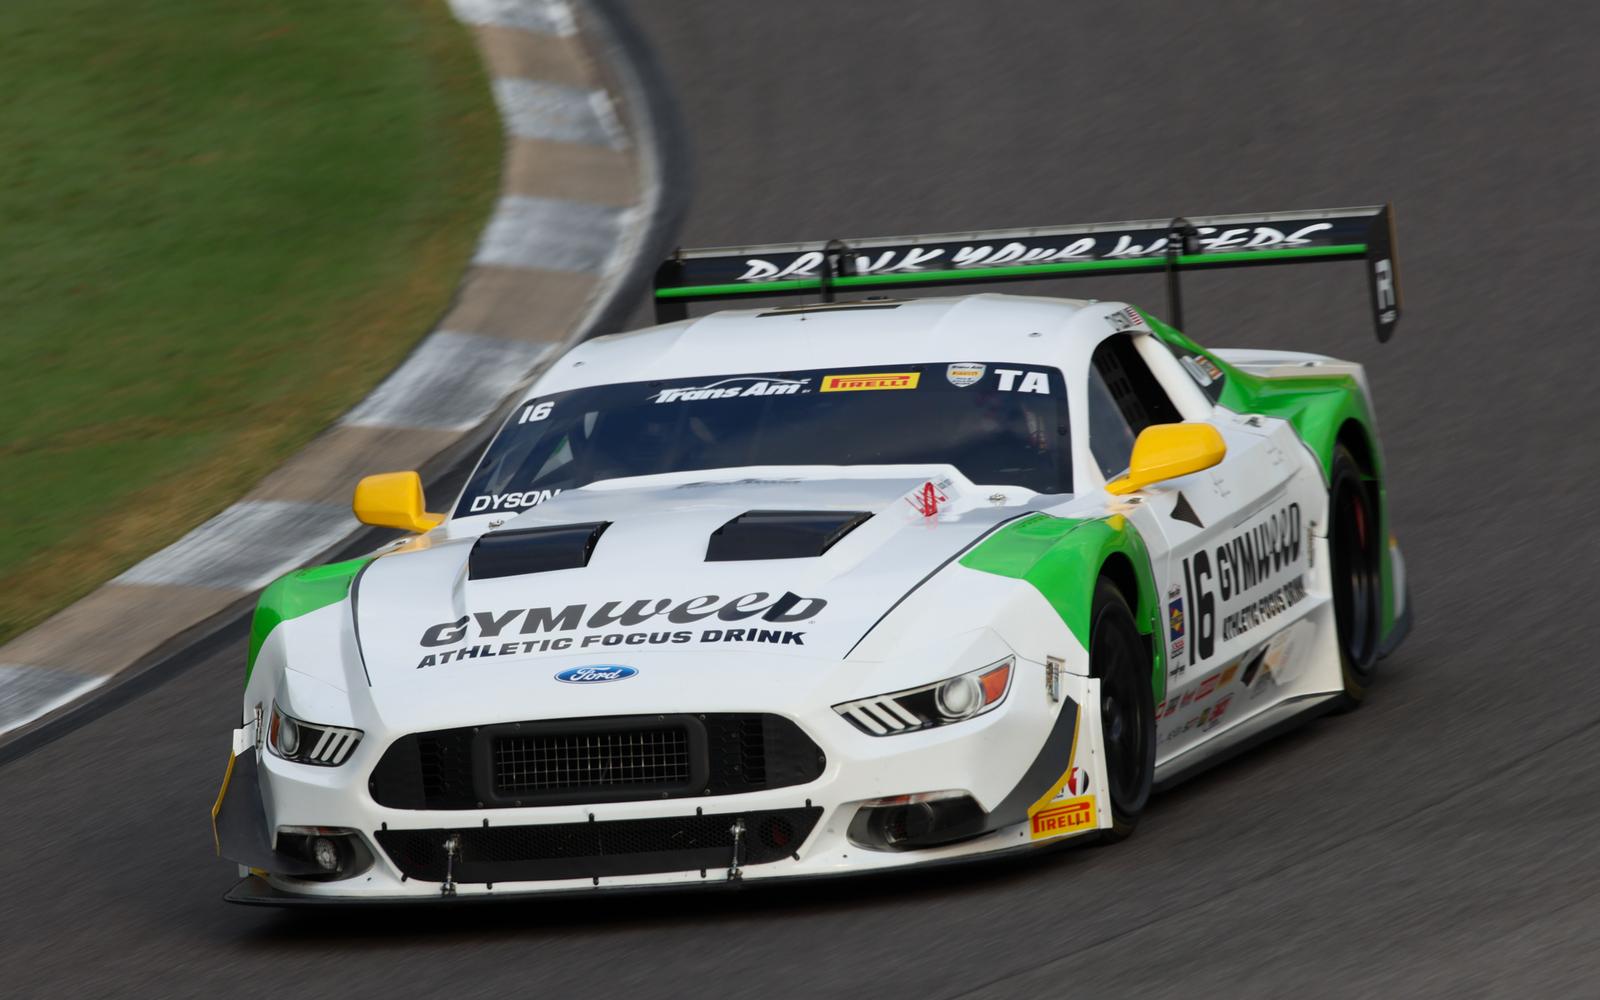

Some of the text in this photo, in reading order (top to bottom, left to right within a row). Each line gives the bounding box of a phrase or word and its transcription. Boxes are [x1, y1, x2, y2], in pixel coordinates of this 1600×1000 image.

[655, 381, 803, 404] Trans Am
[829, 374, 911, 389] PIRELLI
[994, 369, 1051, 395] TA
[518, 401, 555, 424] 16
[1183, 550, 1215, 667] 16
[416, 628, 807, 669] ATHLETIC FOCUS DRINK
[569, 666, 621, 681] Ford
[1032, 802, 1091, 834] PIRELLI
